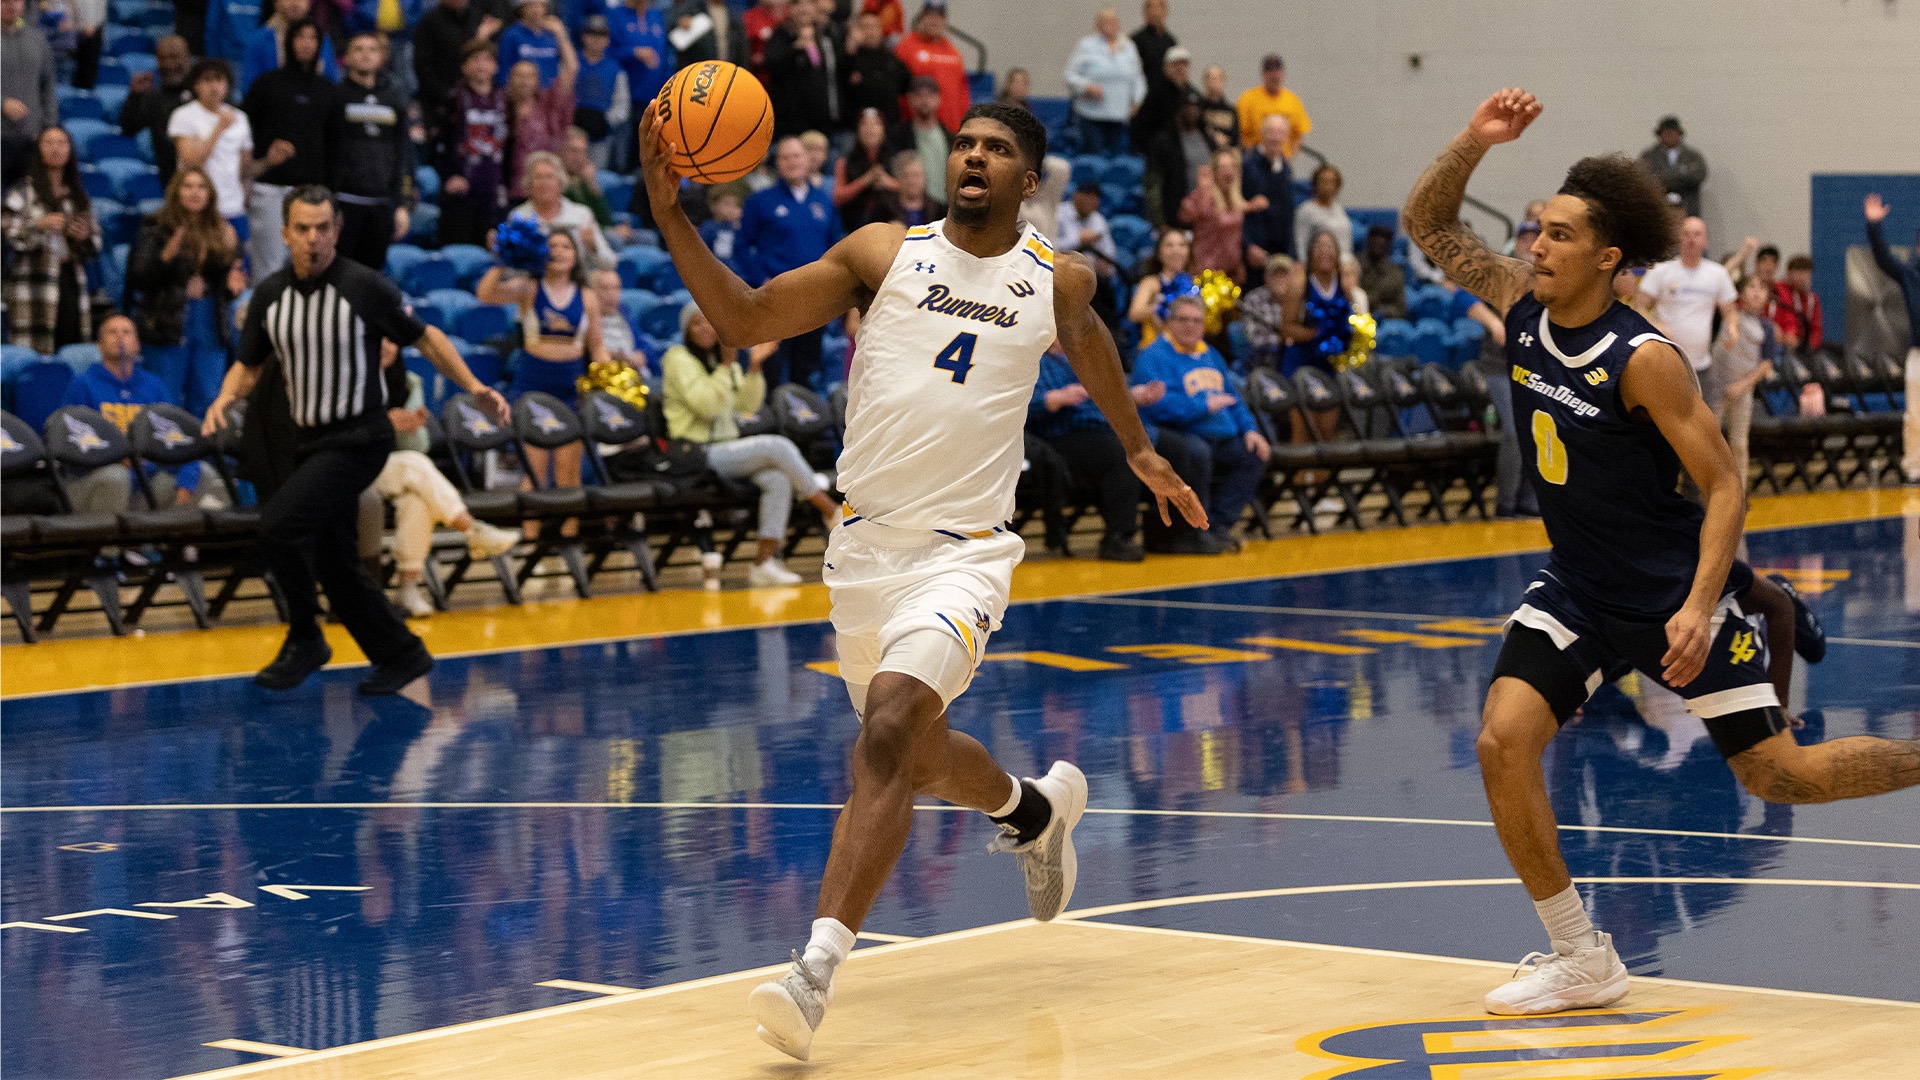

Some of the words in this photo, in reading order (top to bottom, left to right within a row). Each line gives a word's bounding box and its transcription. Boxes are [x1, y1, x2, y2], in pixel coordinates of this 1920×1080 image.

[917, 284, 1019, 328] Runners
[932, 330, 976, 386] 4
[1532, 409, 1568, 485] 0
